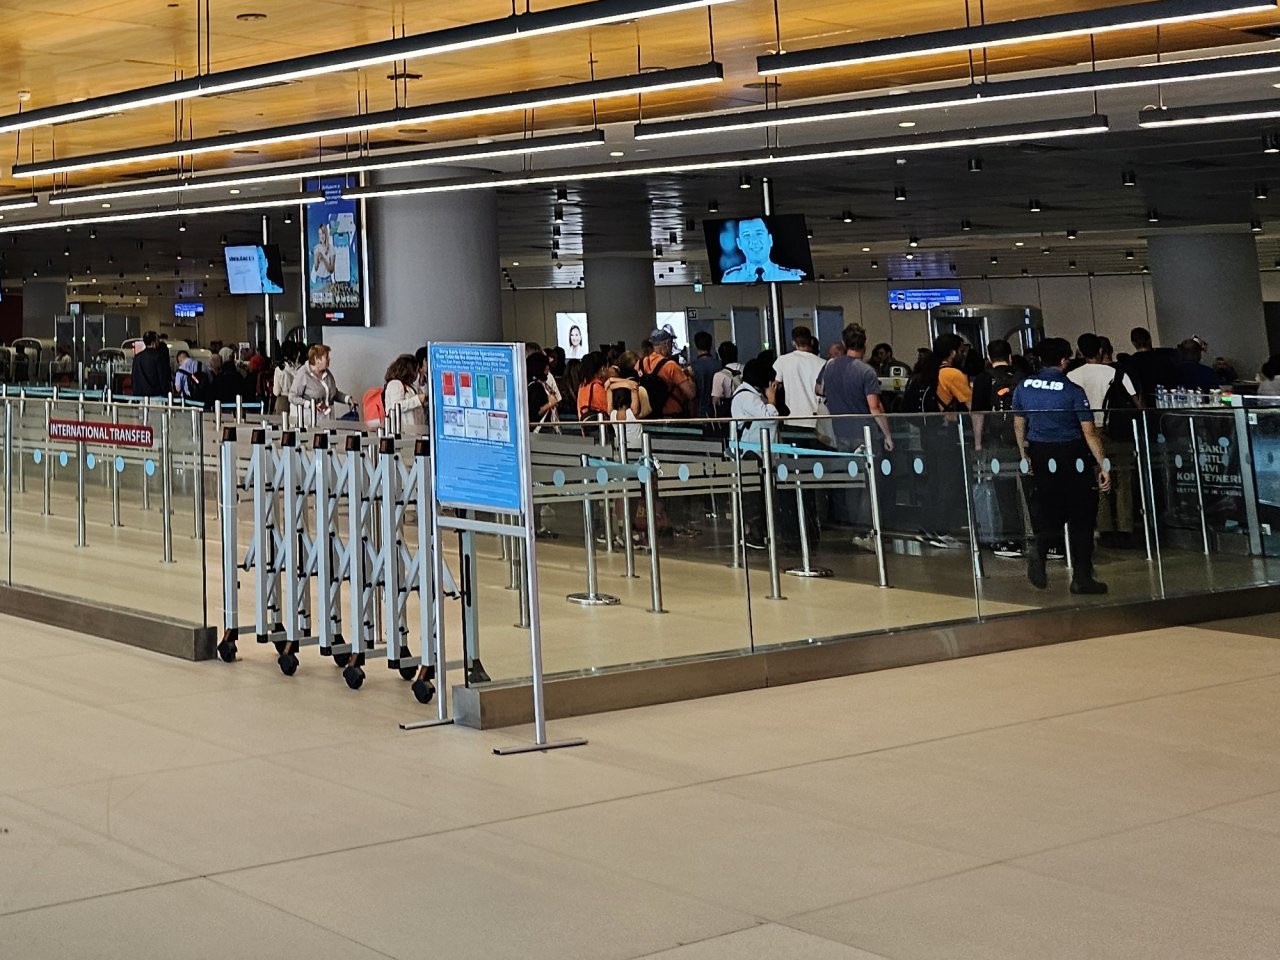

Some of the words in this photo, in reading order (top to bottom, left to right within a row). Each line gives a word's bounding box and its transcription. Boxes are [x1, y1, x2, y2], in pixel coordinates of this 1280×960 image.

[1023, 379, 1064, 391] POLIS
[50, 423, 109, 440] INTERNATIONAL
[110, 428, 152, 444] TRANSFER
